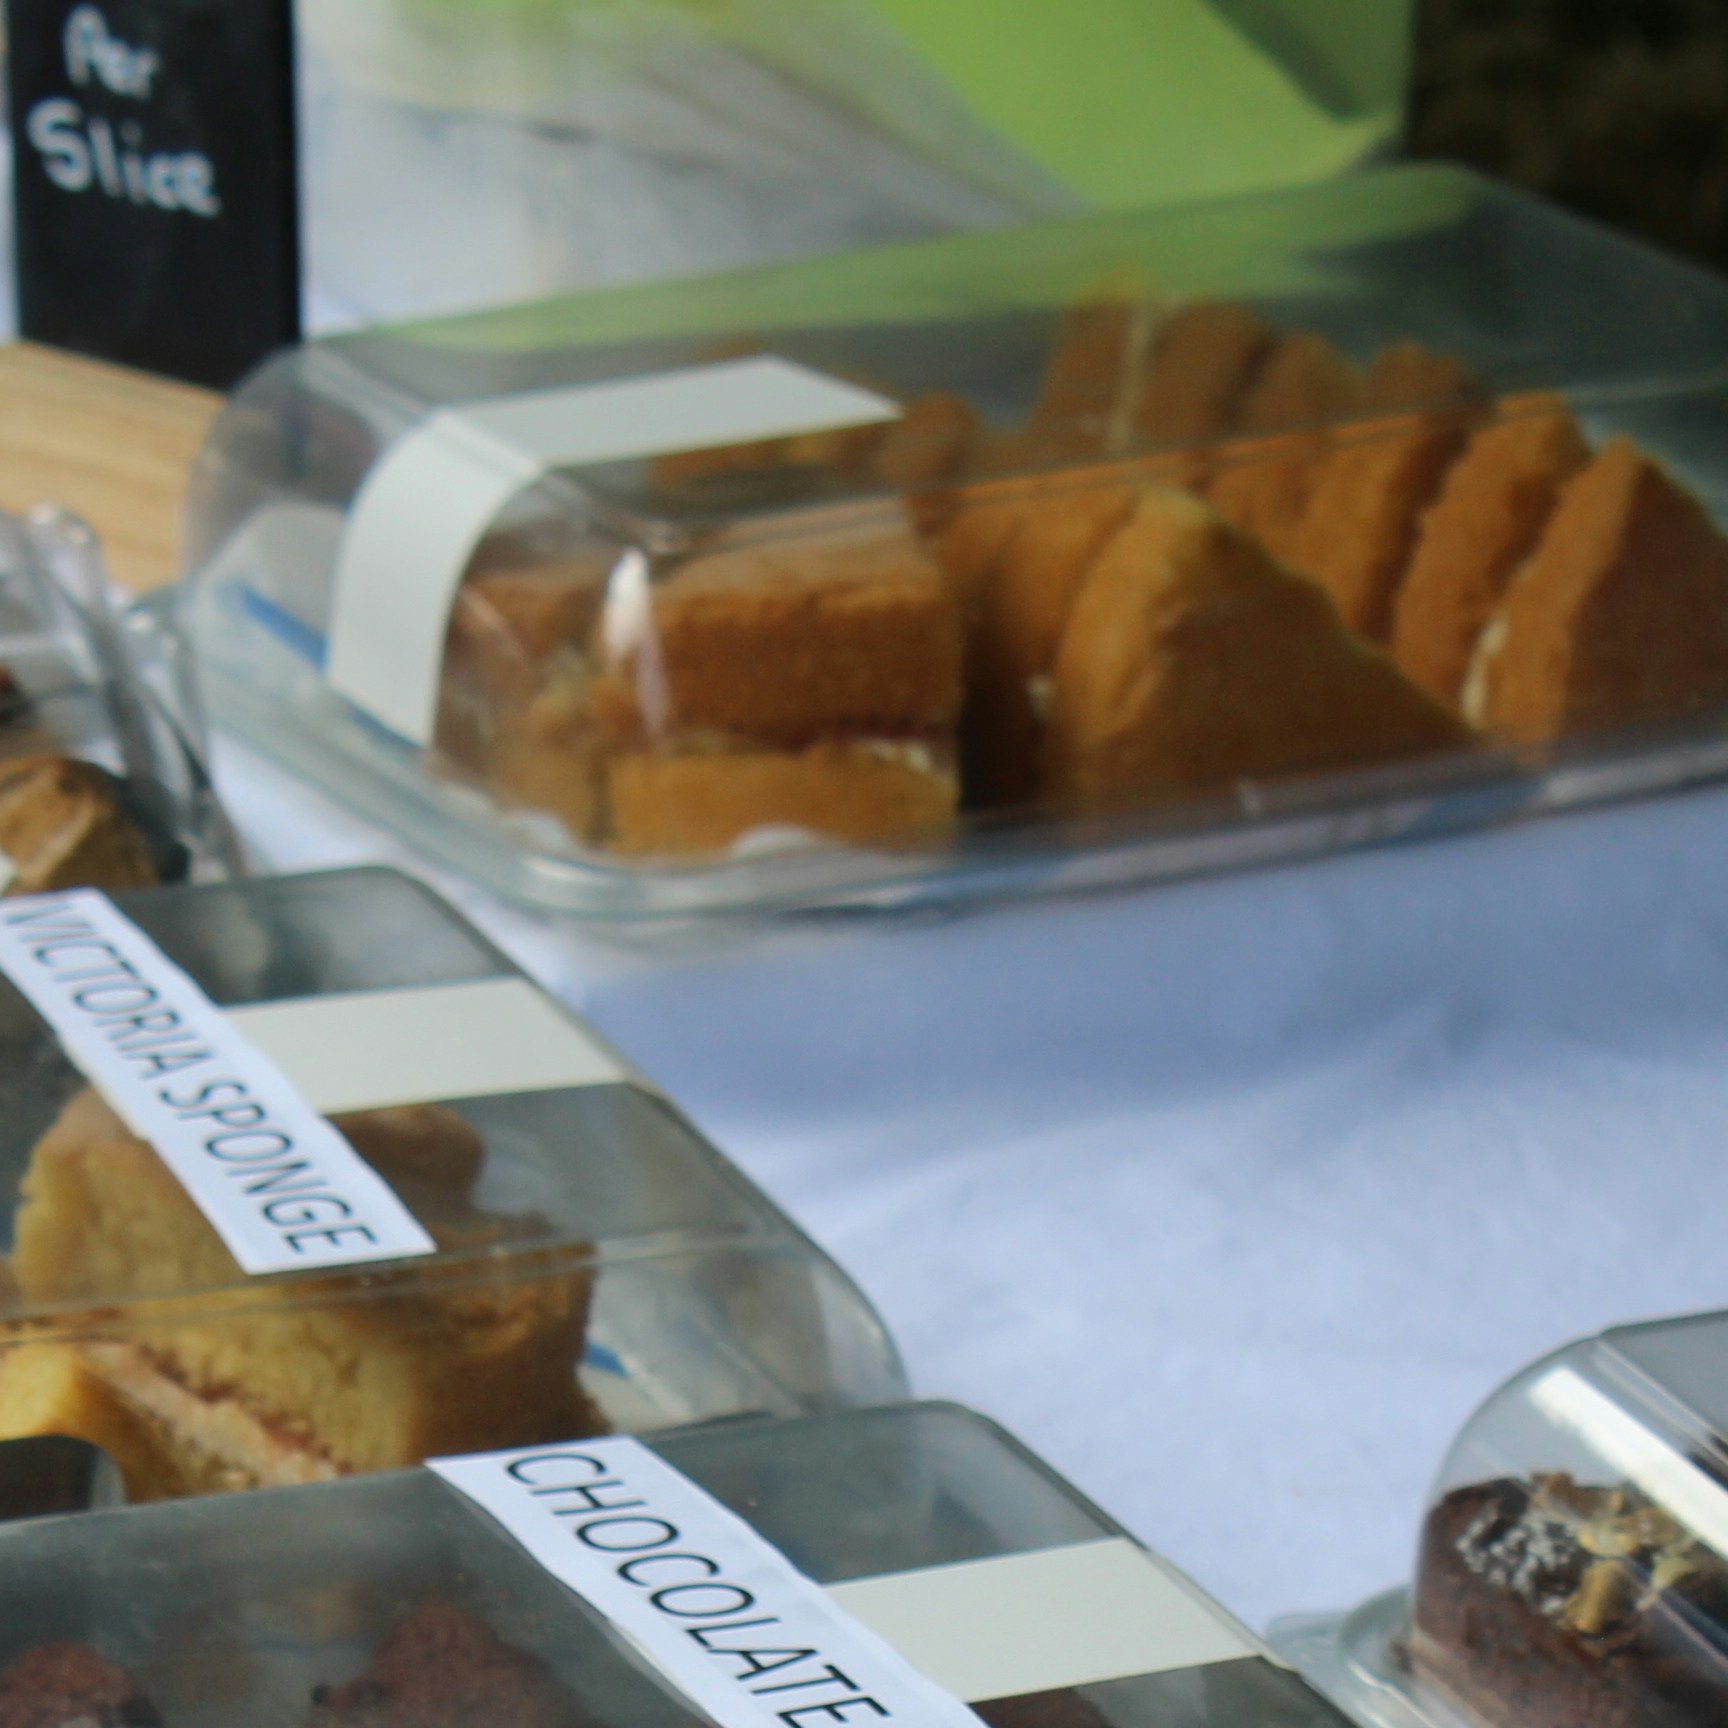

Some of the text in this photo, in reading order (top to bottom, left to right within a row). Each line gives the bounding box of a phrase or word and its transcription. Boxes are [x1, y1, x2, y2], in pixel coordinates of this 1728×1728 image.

[26, 96, 222, 219] Slice
[3, 901, 380, 1254] VICTORIA SPONGE
